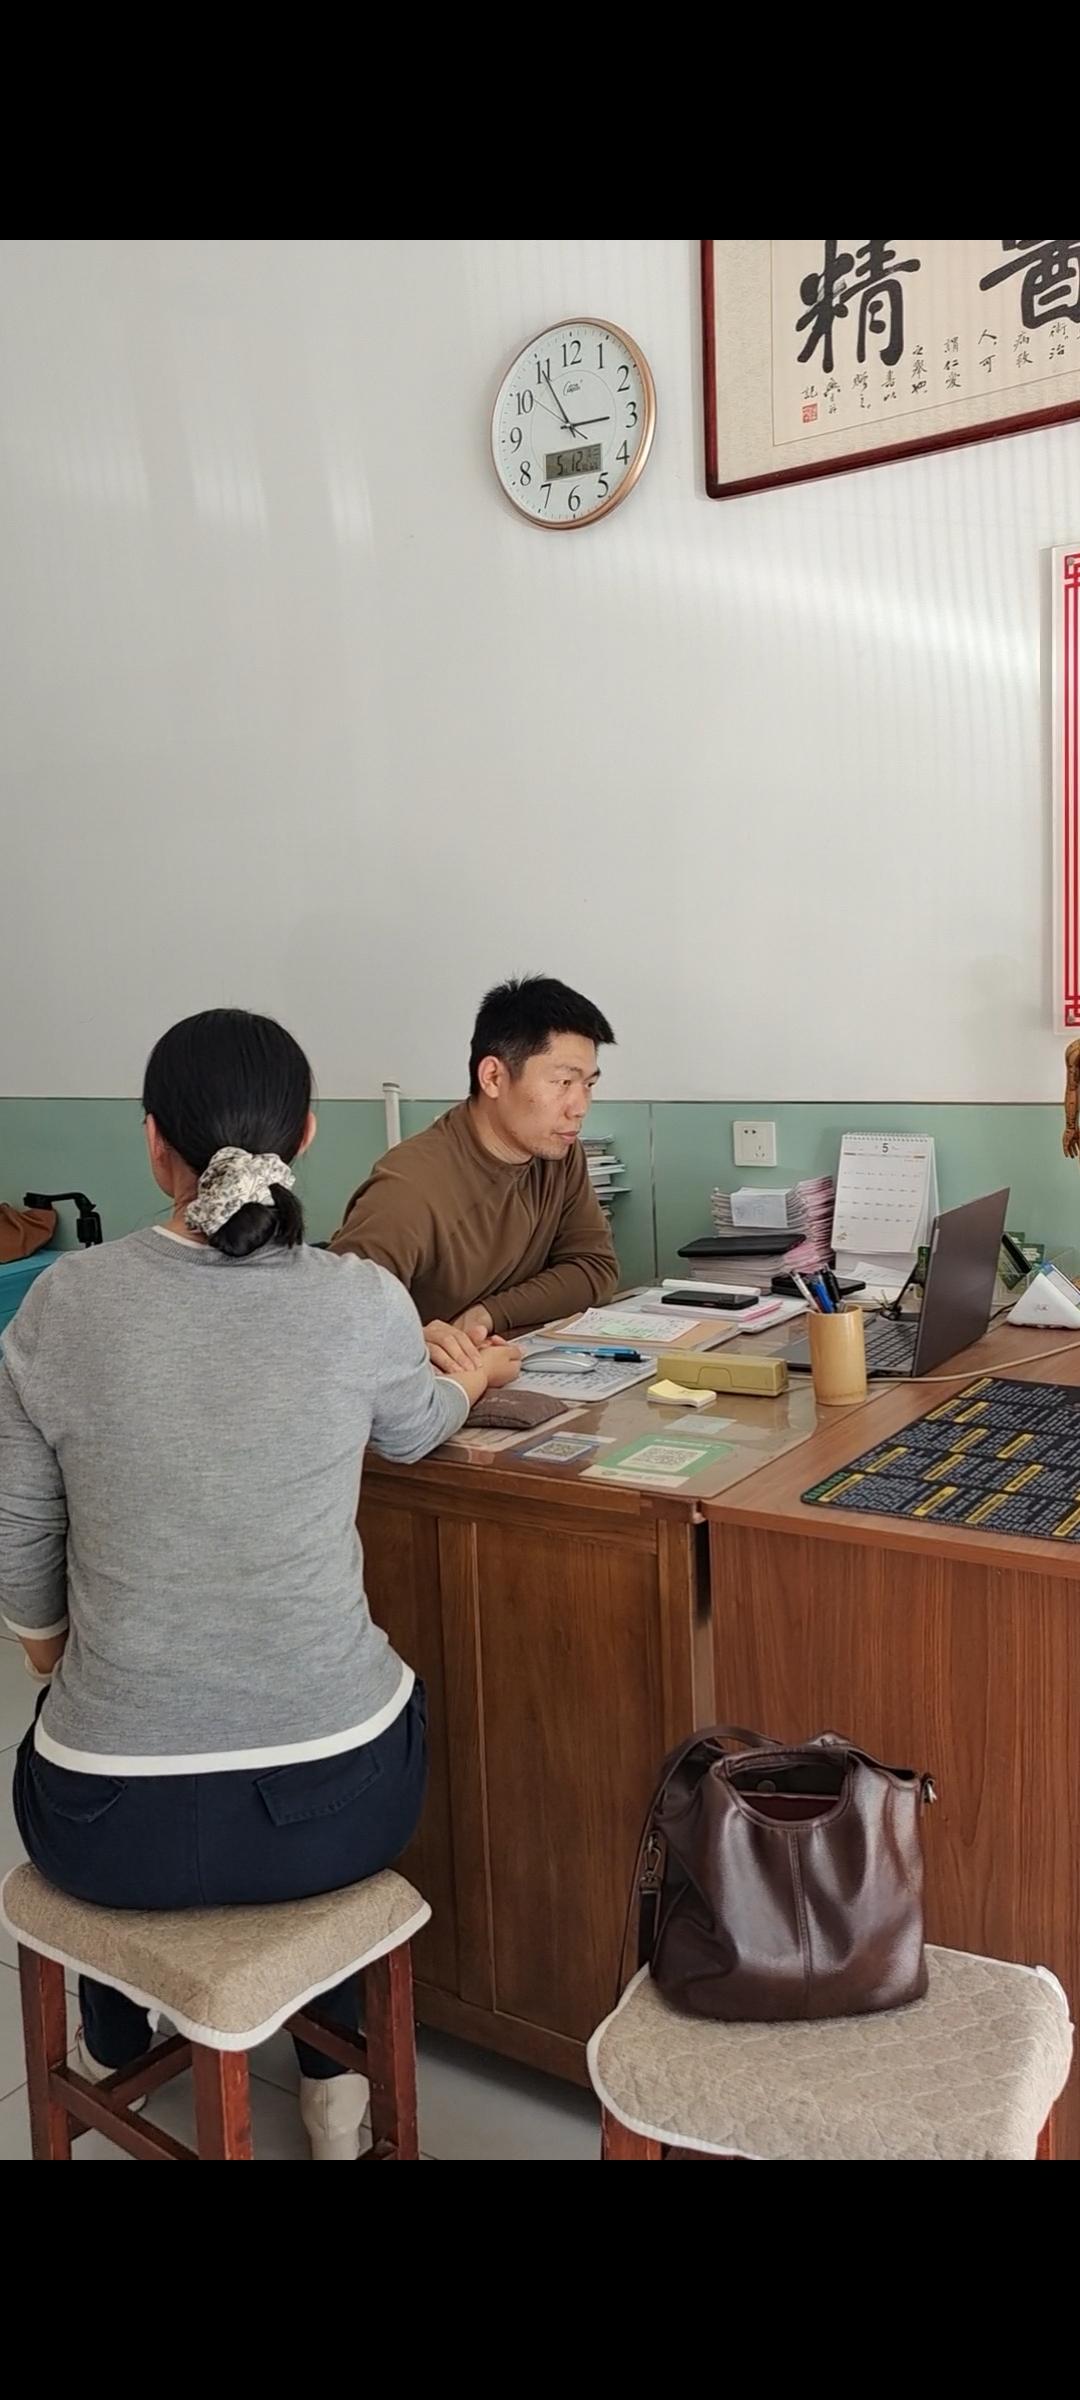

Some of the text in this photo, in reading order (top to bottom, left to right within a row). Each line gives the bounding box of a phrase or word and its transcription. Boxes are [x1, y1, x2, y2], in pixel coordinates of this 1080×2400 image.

[562, 339, 582, 368] 12
[597, 342, 605, 370] 1
[536, 358, 552, 385] 11
[616, 365, 631, 393] 2
[515, 389, 534, 416] 10
[625, 401, 638, 429] 3
[510, 427, 523, 453] 9
[615, 439, 630, 466] 4
[519, 460, 532, 487] 8
[556, 454, 564, 477] 5
[571, 450, 583, 472] 12
[540, 483, 552, 509] 7
[567, 485, 581, 512] 6
[597, 472, 609, 498] 5
[882, 1143, 889, 1153] 5
